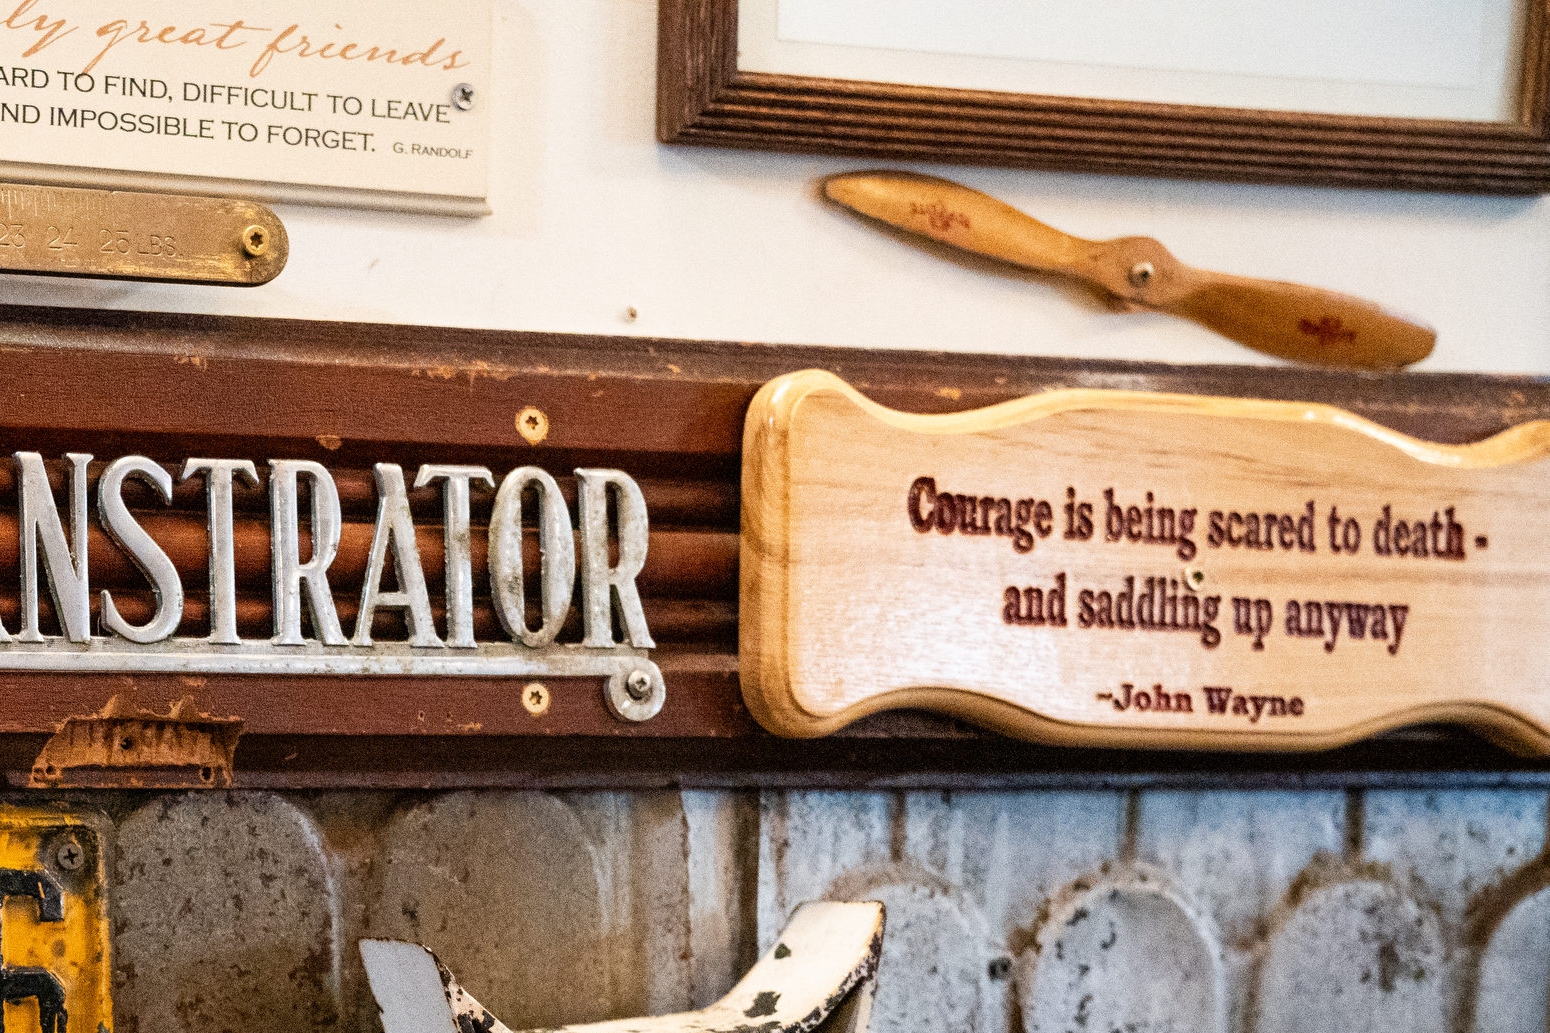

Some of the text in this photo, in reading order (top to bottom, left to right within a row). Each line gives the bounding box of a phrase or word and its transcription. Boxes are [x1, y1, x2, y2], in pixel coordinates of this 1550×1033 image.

[81, 20, 272, 78] great
[249, 23, 471, 78] friends
[57, 70, 95, 93] TO
[104, 75, 173, 103] FIND,
[183, 82, 318, 112] DIFFICULT
[327, 94, 363, 116] TO
[371, 98, 451, 124] LEAVE
[49, 106, 215, 140] IMPOSSIBLE
[221, 120, 259, 143] TO
[267, 125, 376, 153] FORGET.
[393, 141, 408, 155] G.
[411, 143, 474, 160] RANDOLF
[48, 226, 78, 250] 24
[100, 228, 130, 255] 25
[906, 475, 1054, 555] Courage
[1063, 485, 1095, 542] is
[1103, 486, 1198, 562] being
[1207, 499, 1317, 555] scared
[1328, 505, 1361, 555] to
[1002, 571, 1410, 656] and saddling up anyway
[1202, 685, 1305, 725] Wayne
